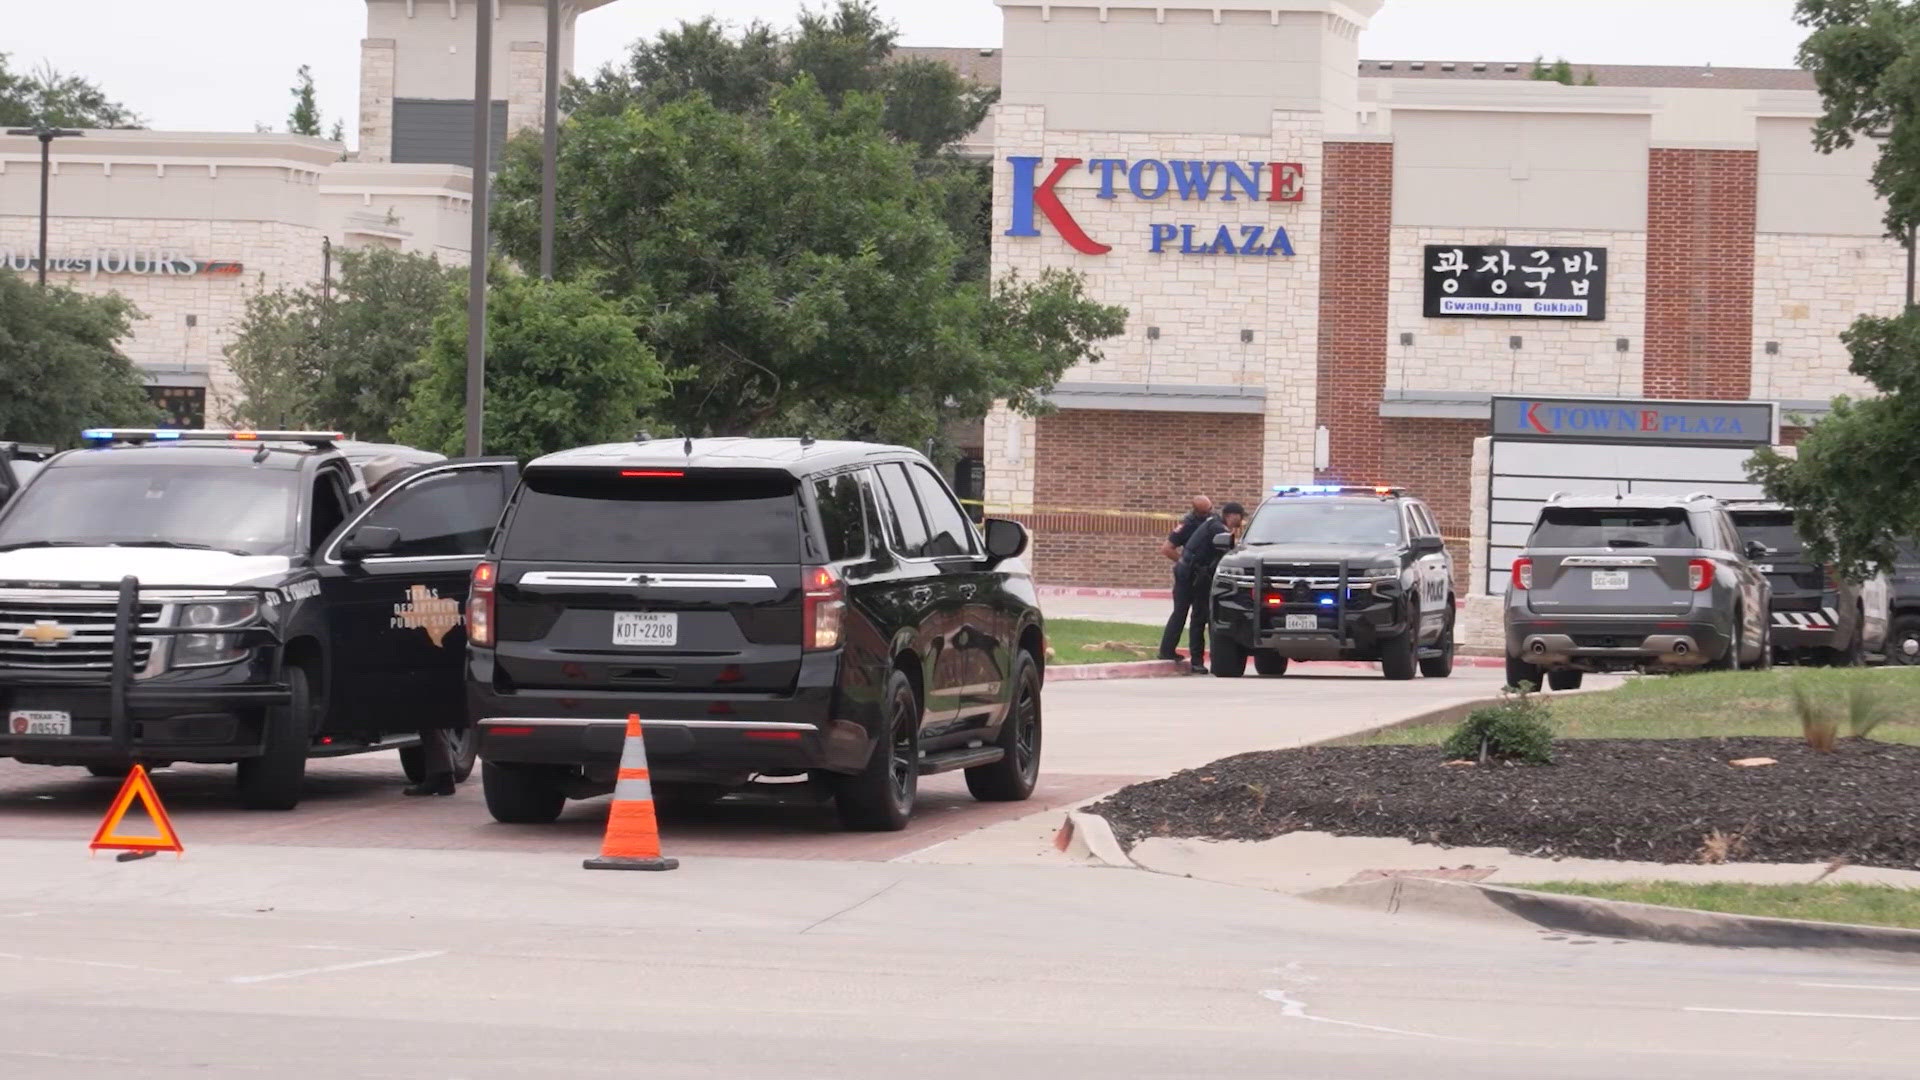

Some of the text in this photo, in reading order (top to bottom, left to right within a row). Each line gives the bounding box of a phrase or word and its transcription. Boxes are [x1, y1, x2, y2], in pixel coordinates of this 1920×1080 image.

[1148, 223, 1296, 256] PLAZA
[89, 247, 197, 280] JOURS
[1432, 248, 1598, 296] 광장국밥
[1662, 415, 1743, 433] PLAZA
[405, 587, 439, 600] TEXAS
[393, 601, 460, 615] DEPARTMENT
[390, 616, 428, 630] PUBLIC
